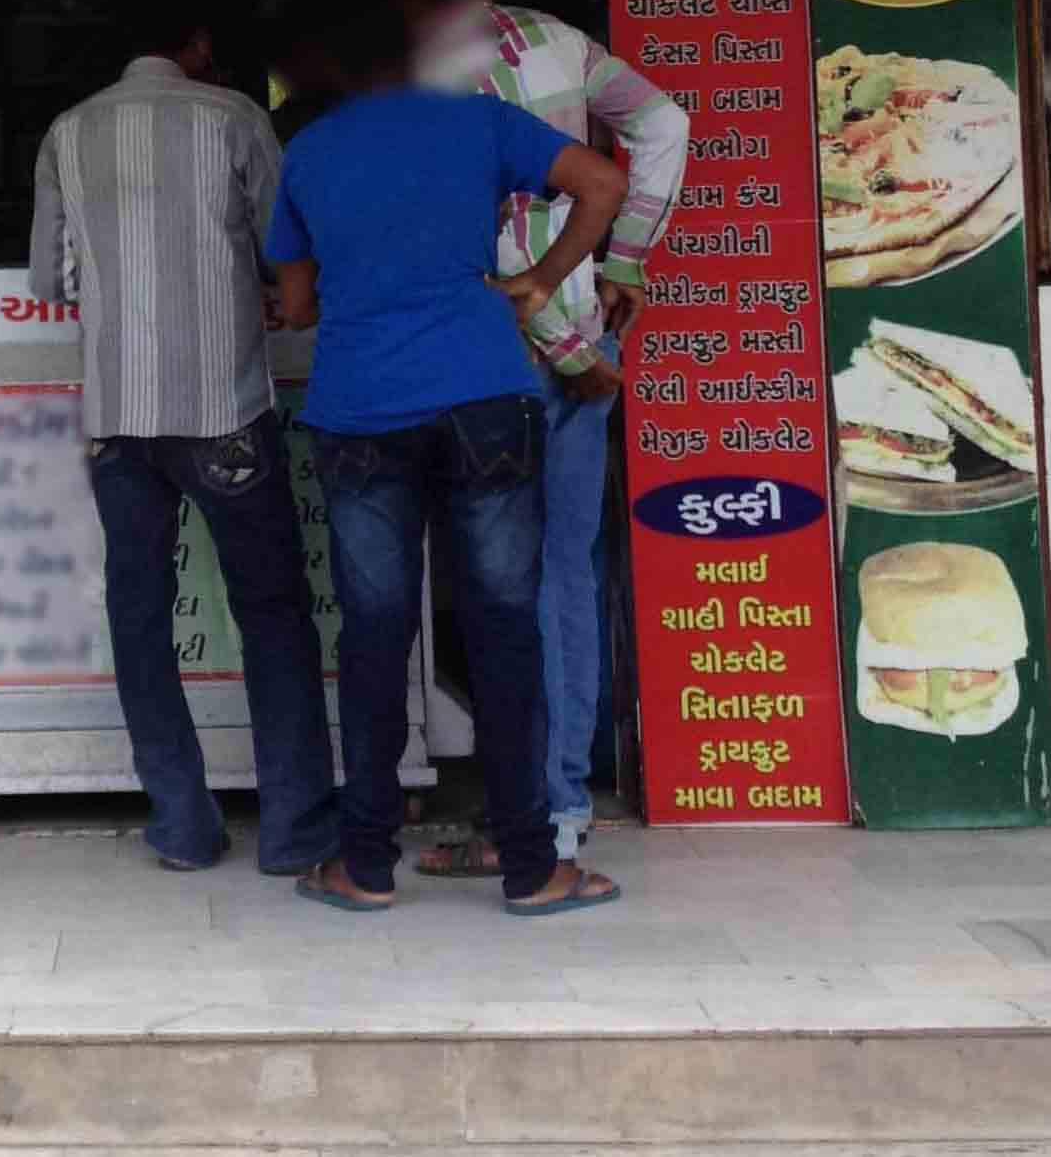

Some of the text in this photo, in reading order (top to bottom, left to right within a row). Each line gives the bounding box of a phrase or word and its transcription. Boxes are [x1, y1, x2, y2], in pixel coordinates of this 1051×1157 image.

[640, 31, 782, 65] કેસર પિસ્તા
[712, 89, 781, 112] બદામ
[688, 128, 769, 160] જભોગ
[678, 185, 724, 208] દામ
[636, 372, 686, 404] જેલી
[722, 419, 814, 451] ચોકલેટ
[677, 481, 781, 535] કુલ્ફી
[695, 553, 768, 584] મલાઈ
[661, 596, 811, 630] શાહી પિસ્તા
[690, 640, 788, 673] ચોકલેટ
[681, 686, 805, 723] સિતાફળ
[675, 785, 822, 809] માવા બદામ
